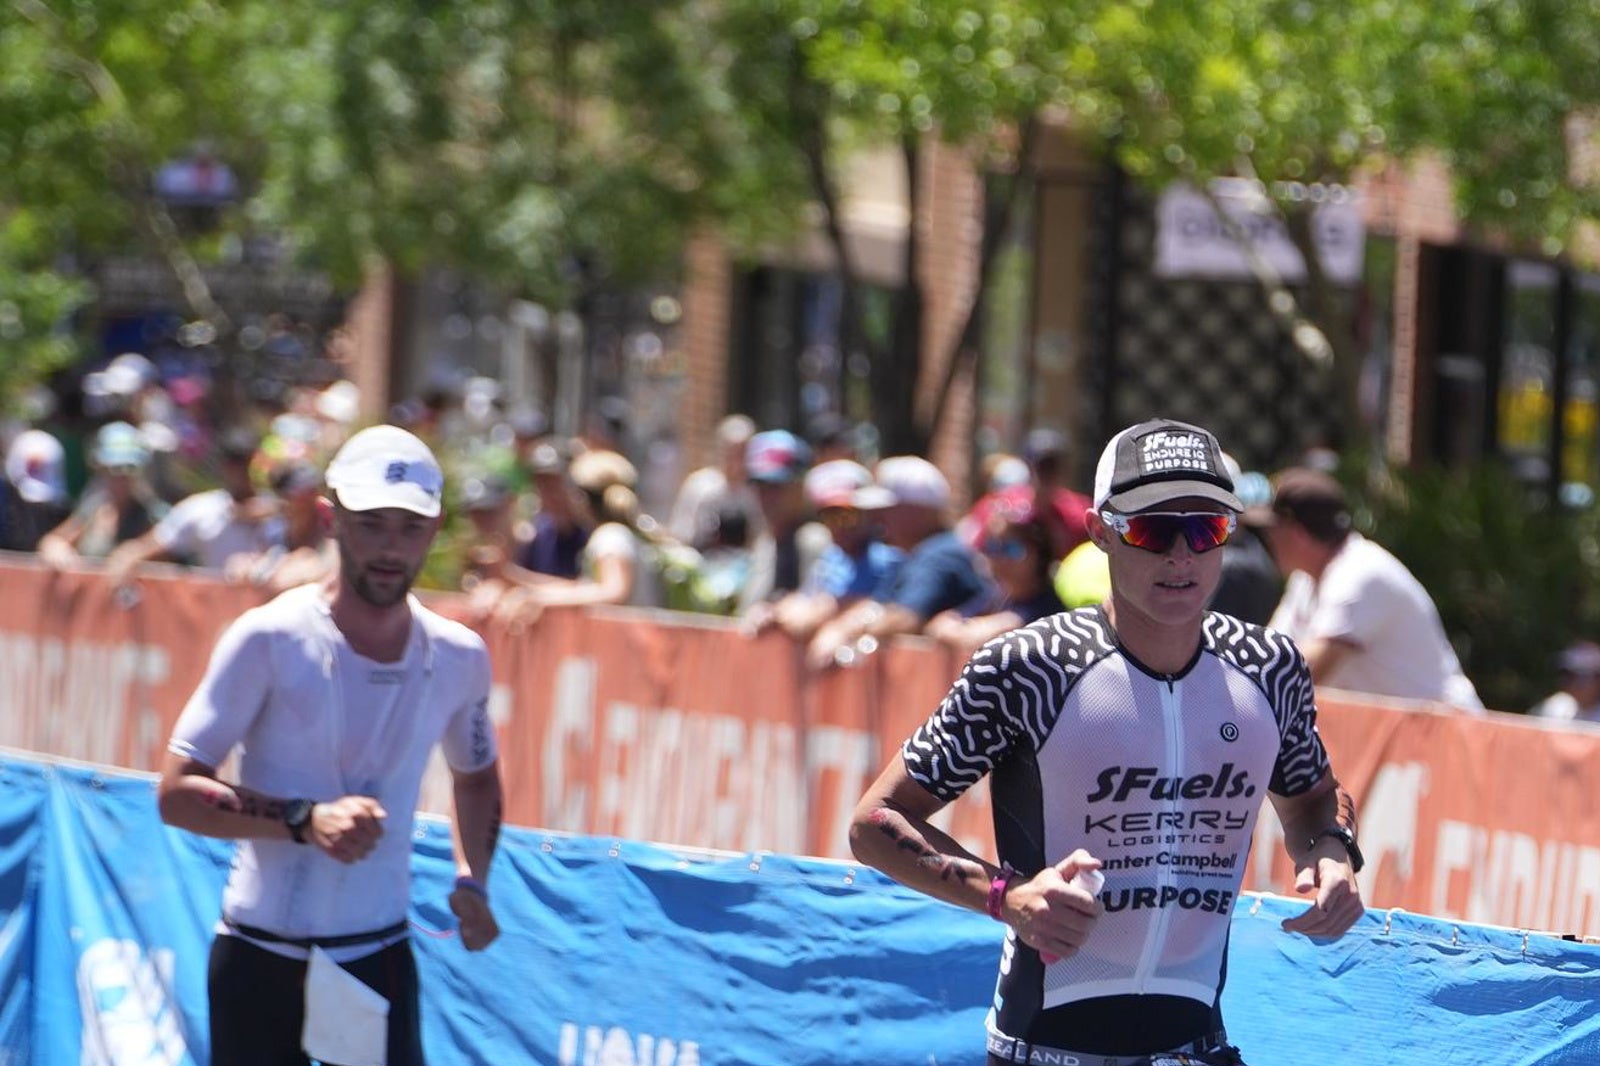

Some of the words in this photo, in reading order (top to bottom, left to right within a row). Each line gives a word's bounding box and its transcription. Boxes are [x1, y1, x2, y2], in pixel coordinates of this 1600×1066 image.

[1143, 432, 1205, 452] SFuels.
[1145, 459, 1208, 471] PURPOSE
[1087, 763, 1256, 803] SFuels.
[1085, 810, 1249, 834] KERRY
[1107, 834, 1226, 848] LOGISTICS
[1100, 854, 1153, 871] unter
[1156, 851, 1237, 870] Campbell
[1099, 886, 1233, 915] URPOSE
